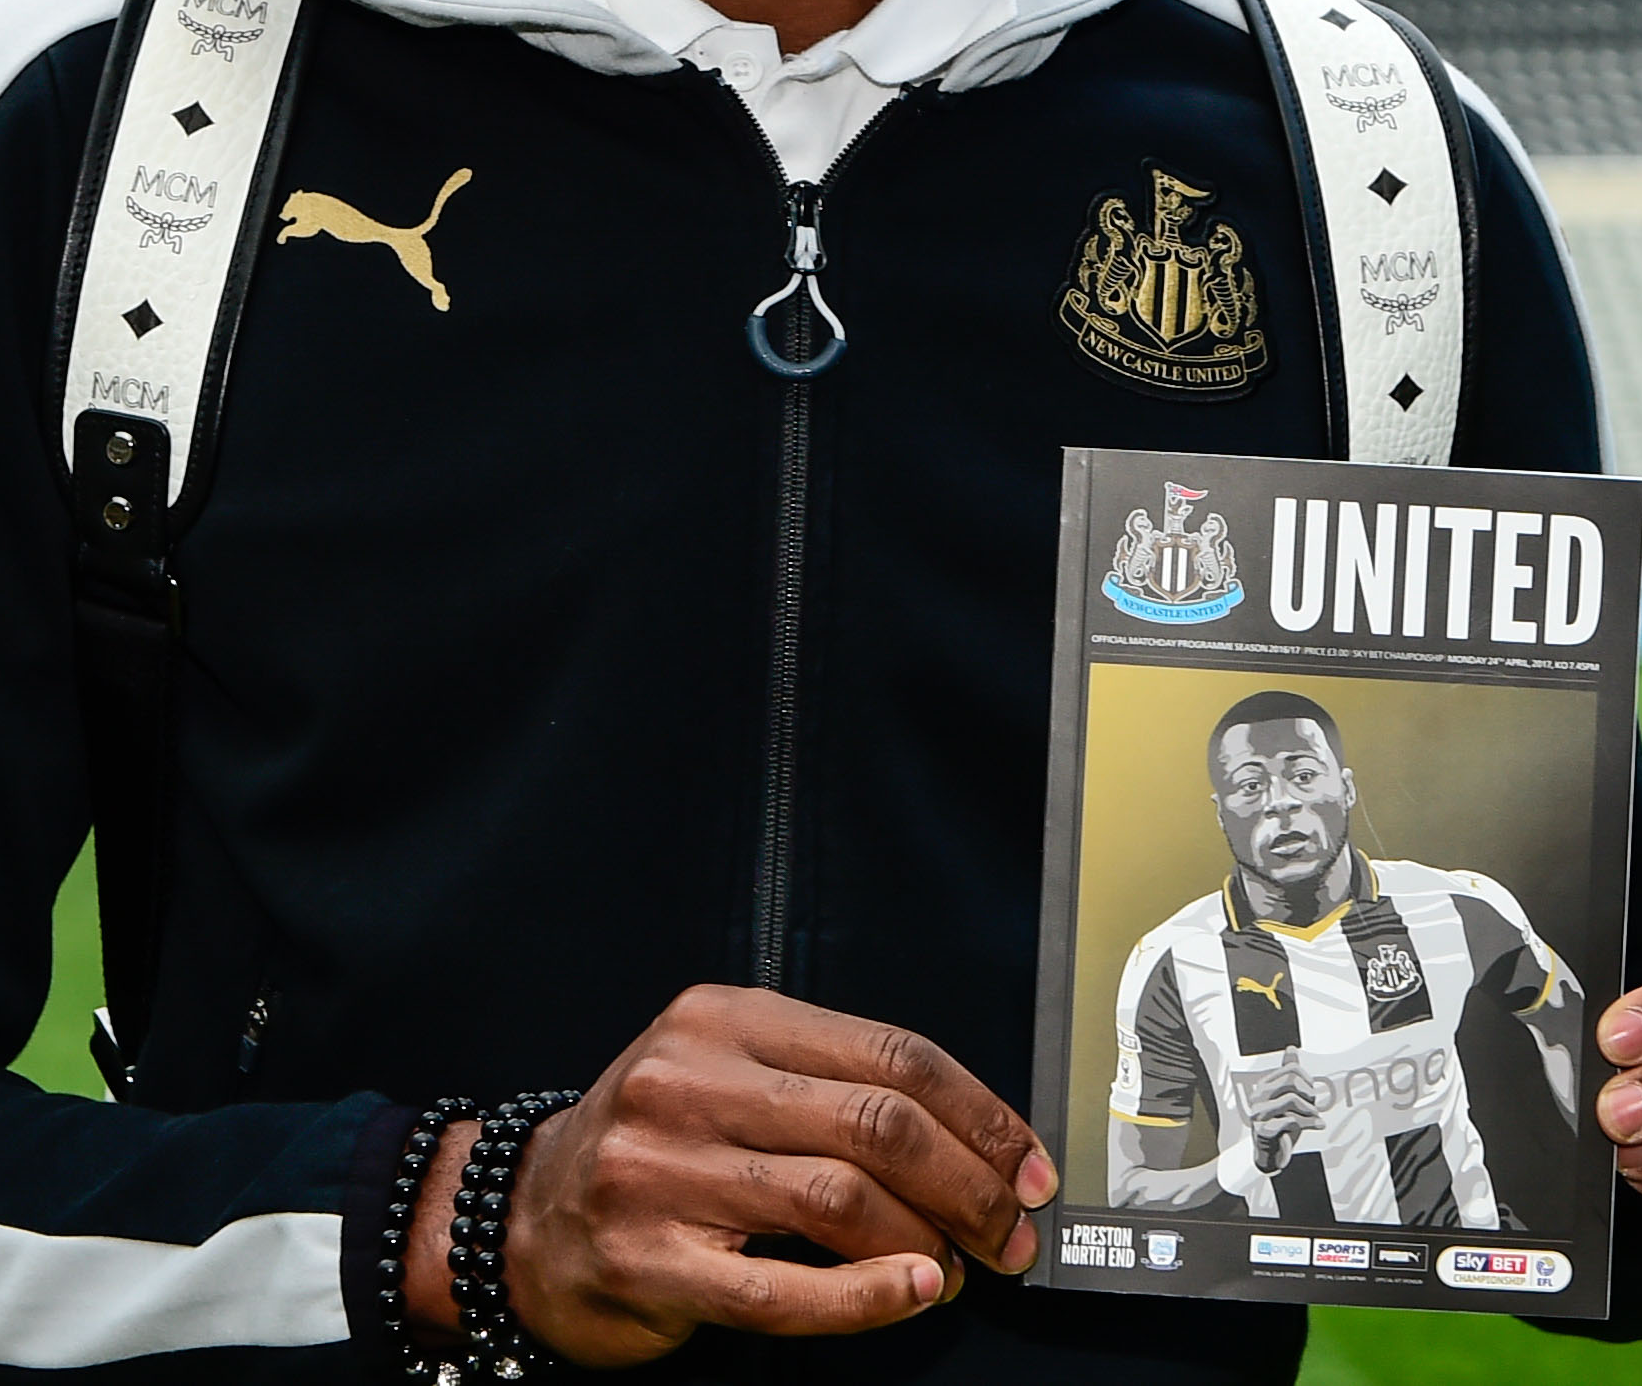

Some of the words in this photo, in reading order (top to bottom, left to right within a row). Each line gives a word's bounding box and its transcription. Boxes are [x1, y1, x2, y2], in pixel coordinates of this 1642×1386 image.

[1321, 62, 1404, 91] MCM
[131, 165, 219, 209] MCM
[1359, 250, 1438, 284] MCM
[1084, 330, 1183, 382] NEWCASTLE
[1186, 364, 1242, 383] UNITED
[90, 371, 170, 414] MCM
[1269, 496, 1605, 647] UNITED
[1121, 597, 1183, 618] NEWCASTLE
[1183, 602, 1224, 618] UNITED
[1352, 649, 1368, 658] SKY
[1369, 650, 1383, 659] BET
[1384, 651, 1445, 662] CHAMPIONSHIP
[1447, 654, 1487, 665] MONDAY
[1061, 1228, 1071, 1243] v
[1072, 1224, 1133, 1248] PRESTON
[1060, 1243, 1106, 1267] NORTH
[1107, 1246, 1136, 1269] END
[1317, 1243, 1366, 1255] SPORTS
[1456, 1252, 1487, 1271] sky
[1491, 1257, 1526, 1272] BET
[1453, 1273, 1526, 1286] CHAMPIONSHIP
[1536, 1277, 1553, 1288] EFL
